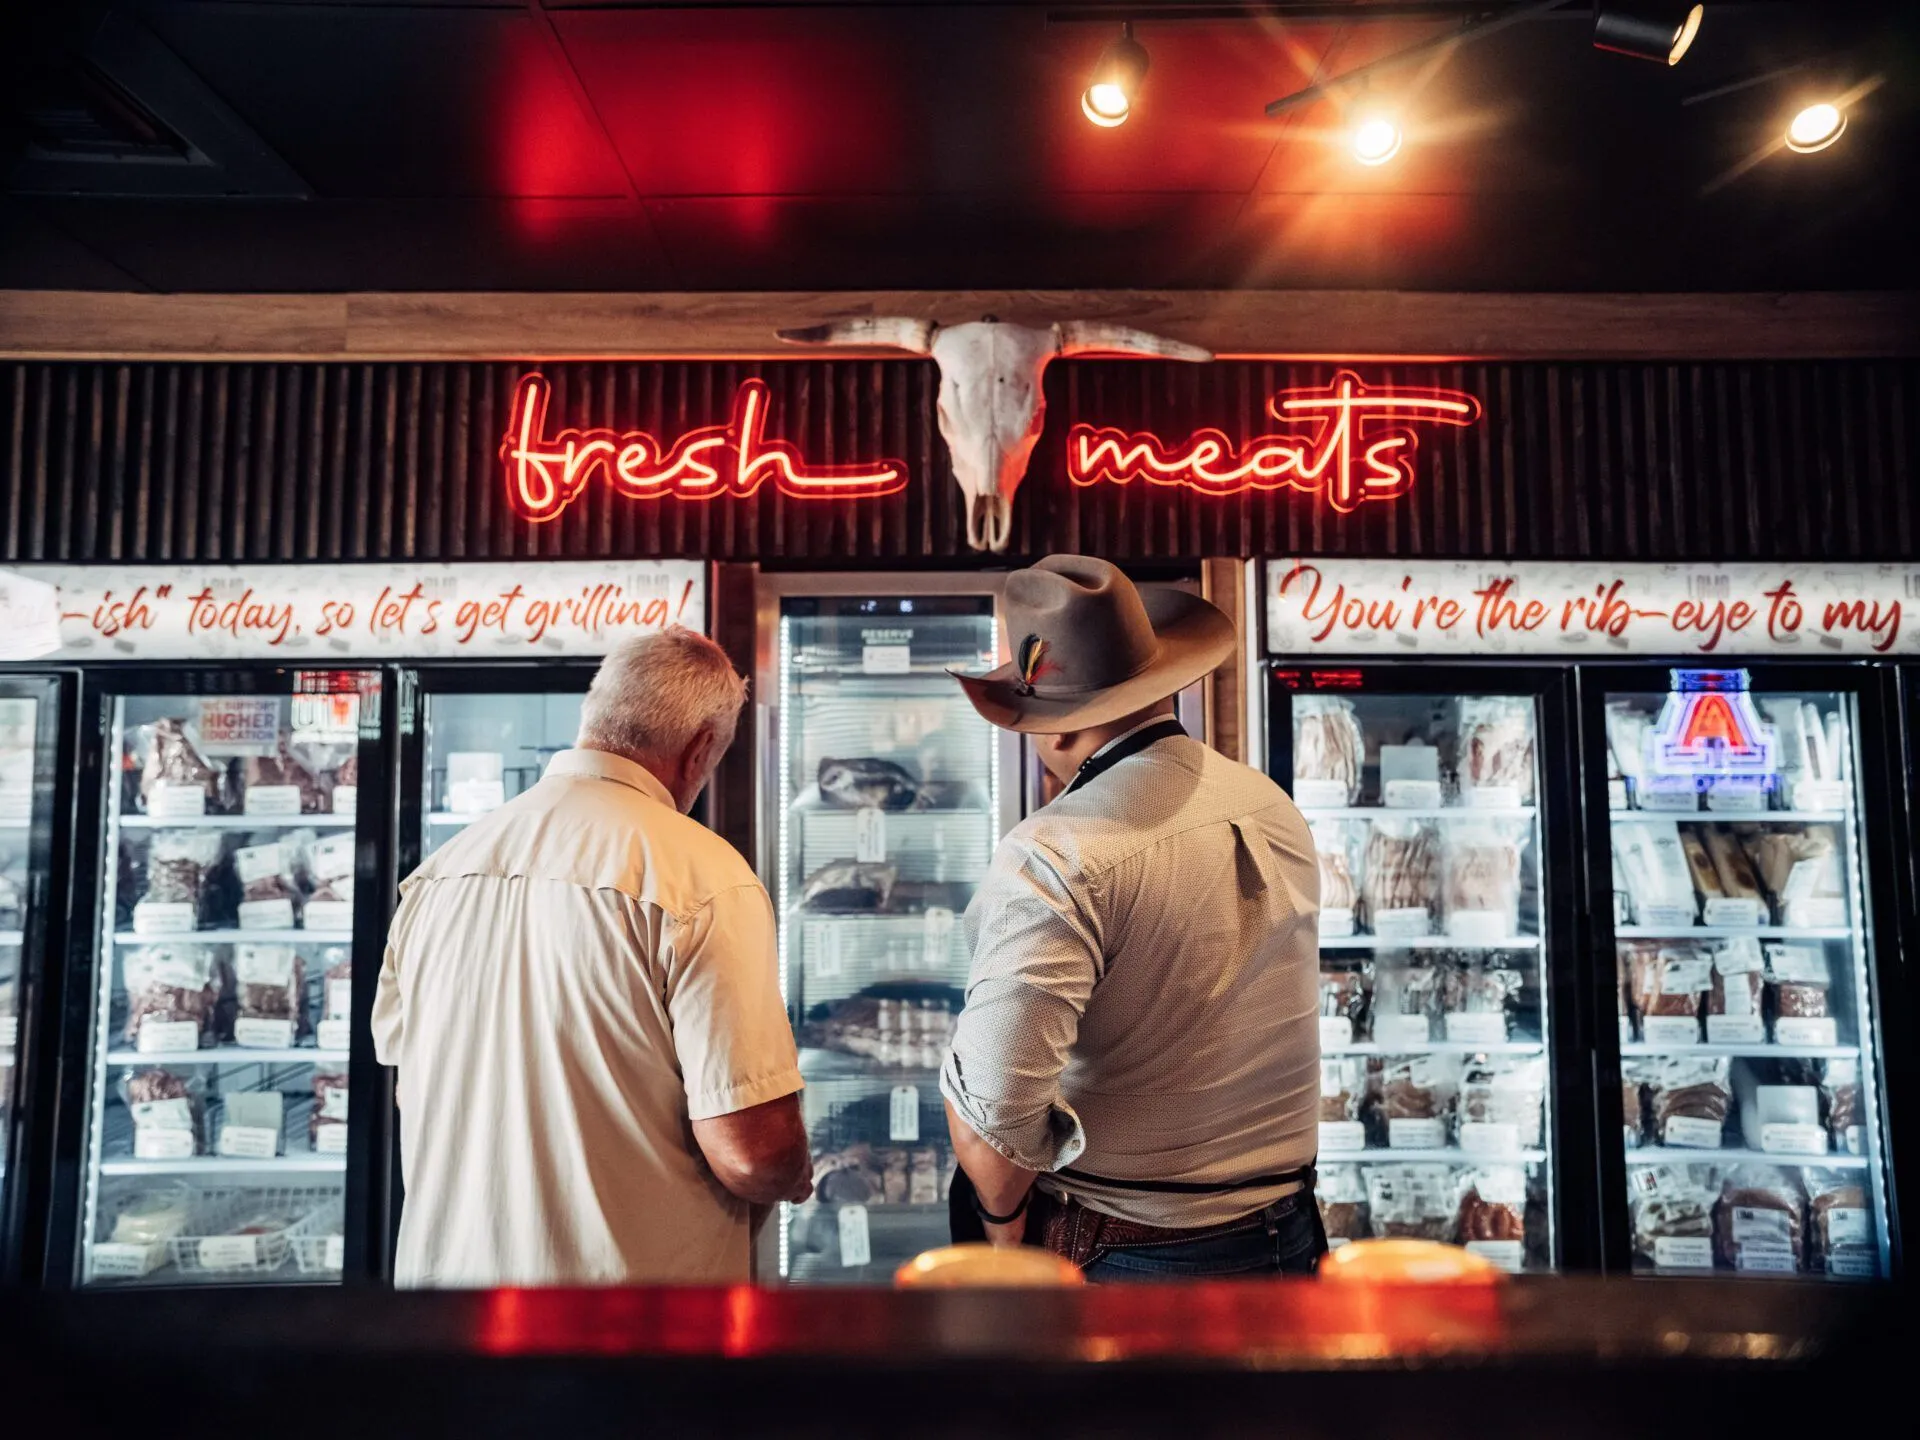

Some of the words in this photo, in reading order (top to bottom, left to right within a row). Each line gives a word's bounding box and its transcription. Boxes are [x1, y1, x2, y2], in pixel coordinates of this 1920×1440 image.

[505, 376, 905, 515] fresh
[1075, 375, 1474, 505] meats
[57, 584, 173, 638] -ish"
[187, 587, 302, 646] today,
[315, 600, 355, 636] so
[369, 582, 442, 635] let's
[455, 584, 526, 644] get
[524, 579, 695, 644] grilling!
[1279, 565, 1467, 643] You're
[1472, 577, 1552, 640] the
[1559, 578, 1758, 651] rib-eye
[1762, 579, 1803, 643] to
[1821, 599, 1902, 652] my
[202, 713, 276, 729] HIGHER
[202, 730, 275, 740] EDUCATION
